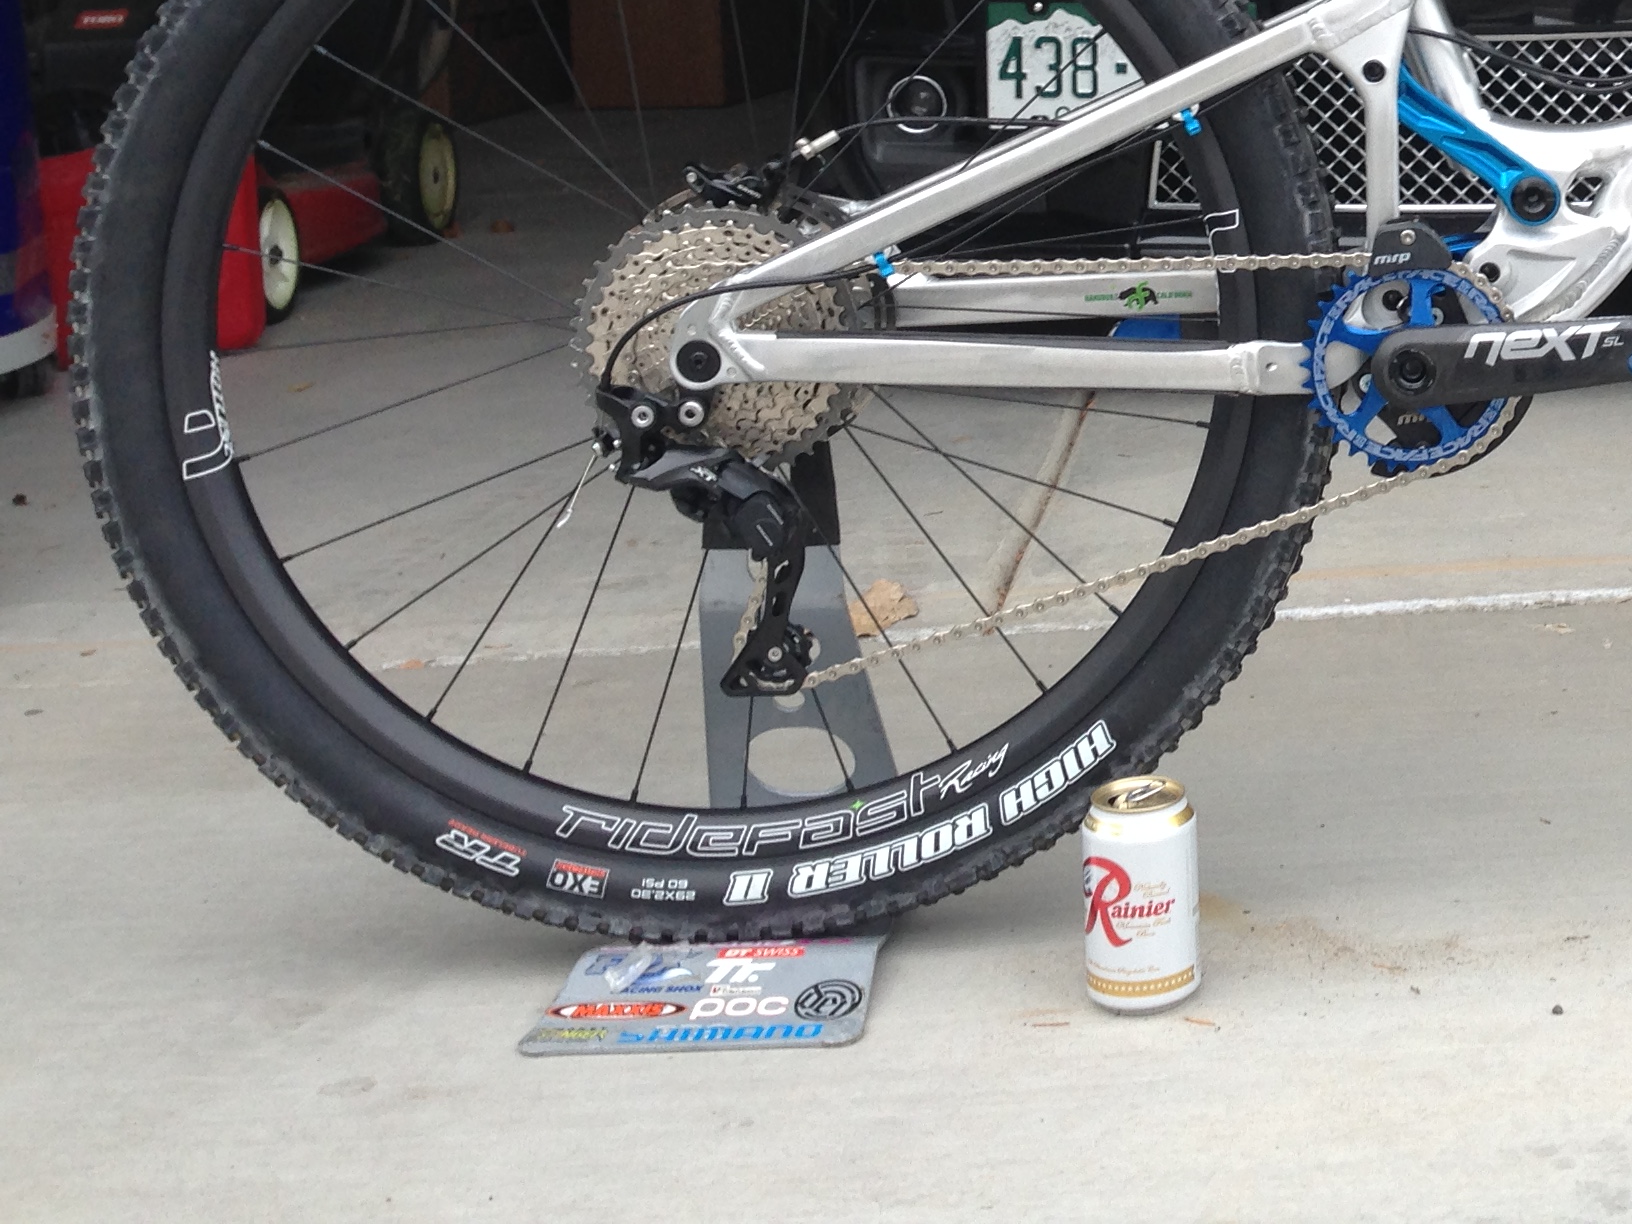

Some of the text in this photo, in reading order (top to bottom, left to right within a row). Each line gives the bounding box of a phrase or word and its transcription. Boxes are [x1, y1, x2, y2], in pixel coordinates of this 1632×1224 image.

[1373, 252, 1412, 265] mrp
[1601, 335, 1625, 348] SL
[938, 742, 1010, 799] Racing
[1000, 719, 1116, 827] HIGH
[436, 829, 521, 878] TR
[787, 802, 993, 898] ROLLER
[550, 871, 603, 895] EXO
[641, 878, 689, 890] 60 PSI
[1083, 856, 1176, 947] Rainier
[754, 946, 800, 957] SWISS
[617, 1023, 824, 1043] SHIMANO
